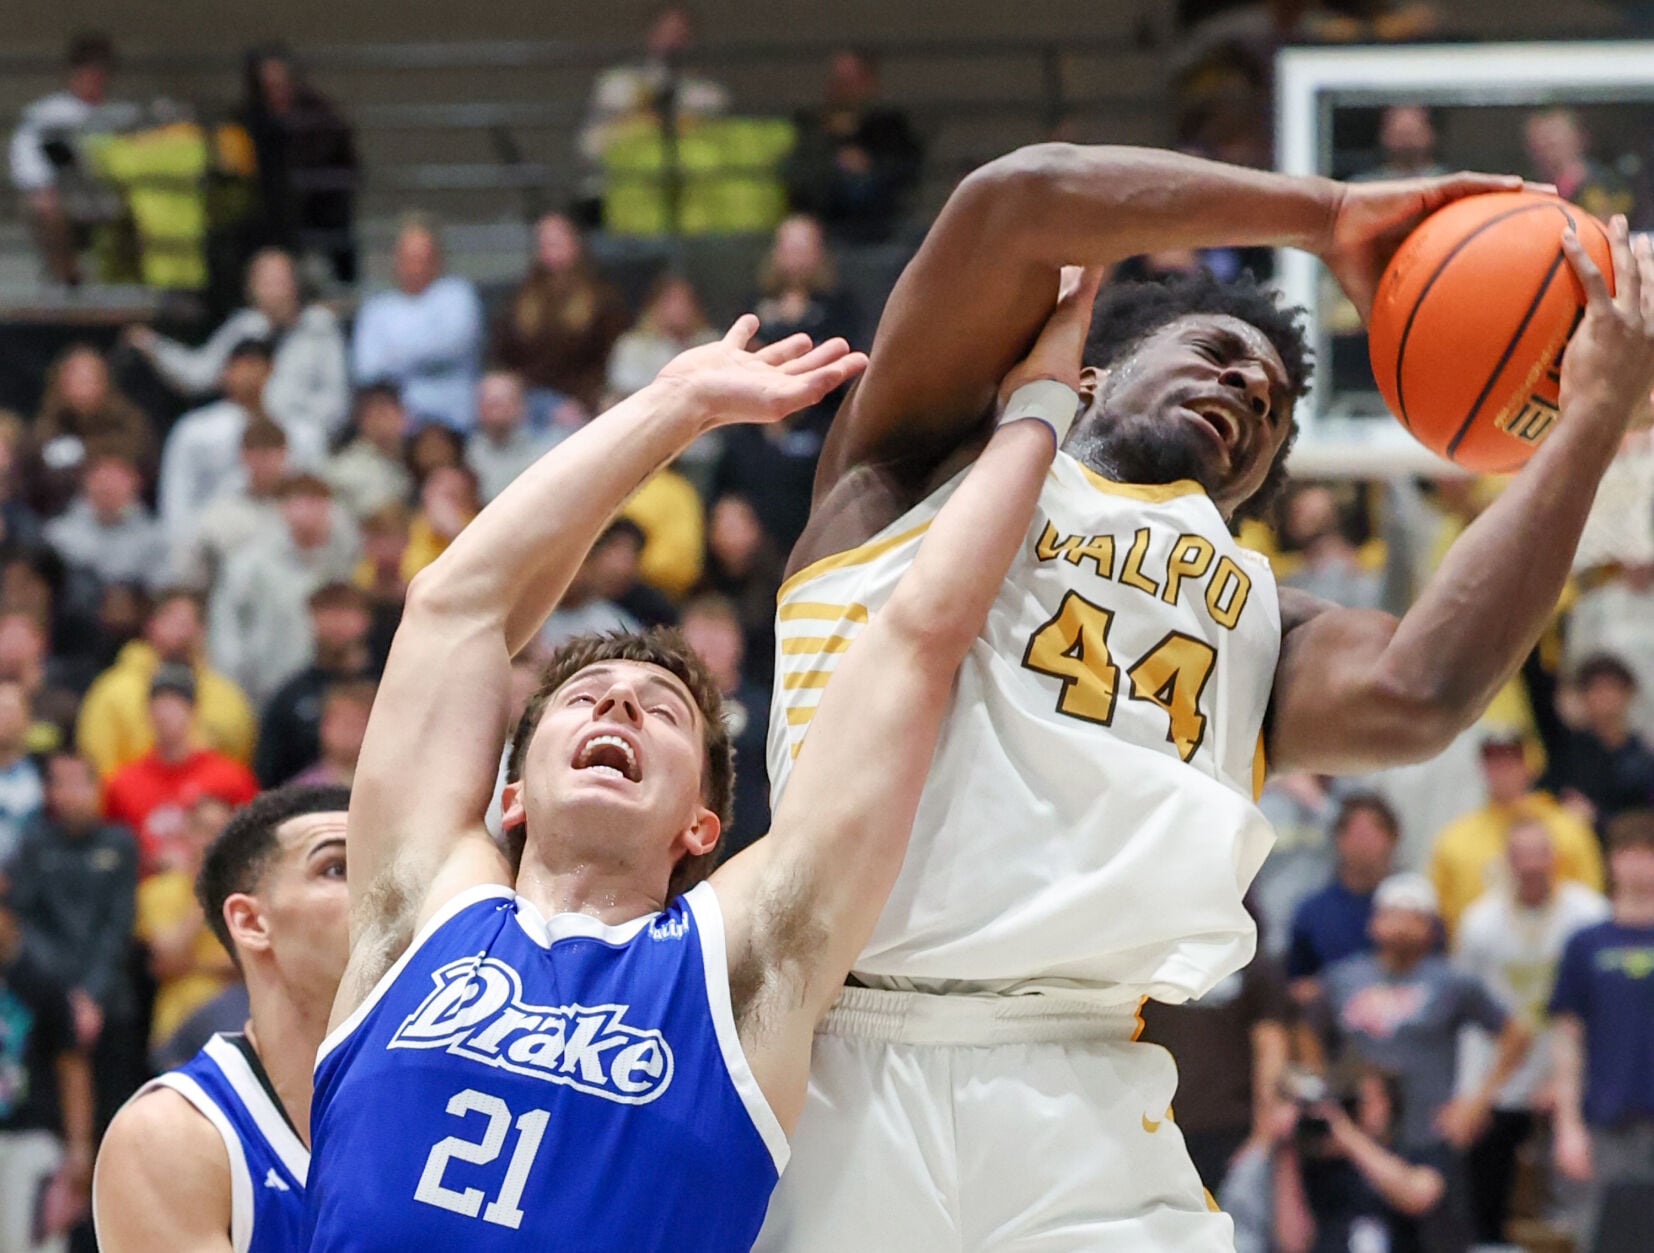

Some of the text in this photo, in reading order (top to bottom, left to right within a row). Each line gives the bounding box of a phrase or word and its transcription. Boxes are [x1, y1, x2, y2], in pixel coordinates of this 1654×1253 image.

[1035, 519, 1252, 630] VALPO
[1021, 588, 1218, 763] 44
[386, 950, 674, 1105] Drake
[413, 1088, 551, 1230] 21
